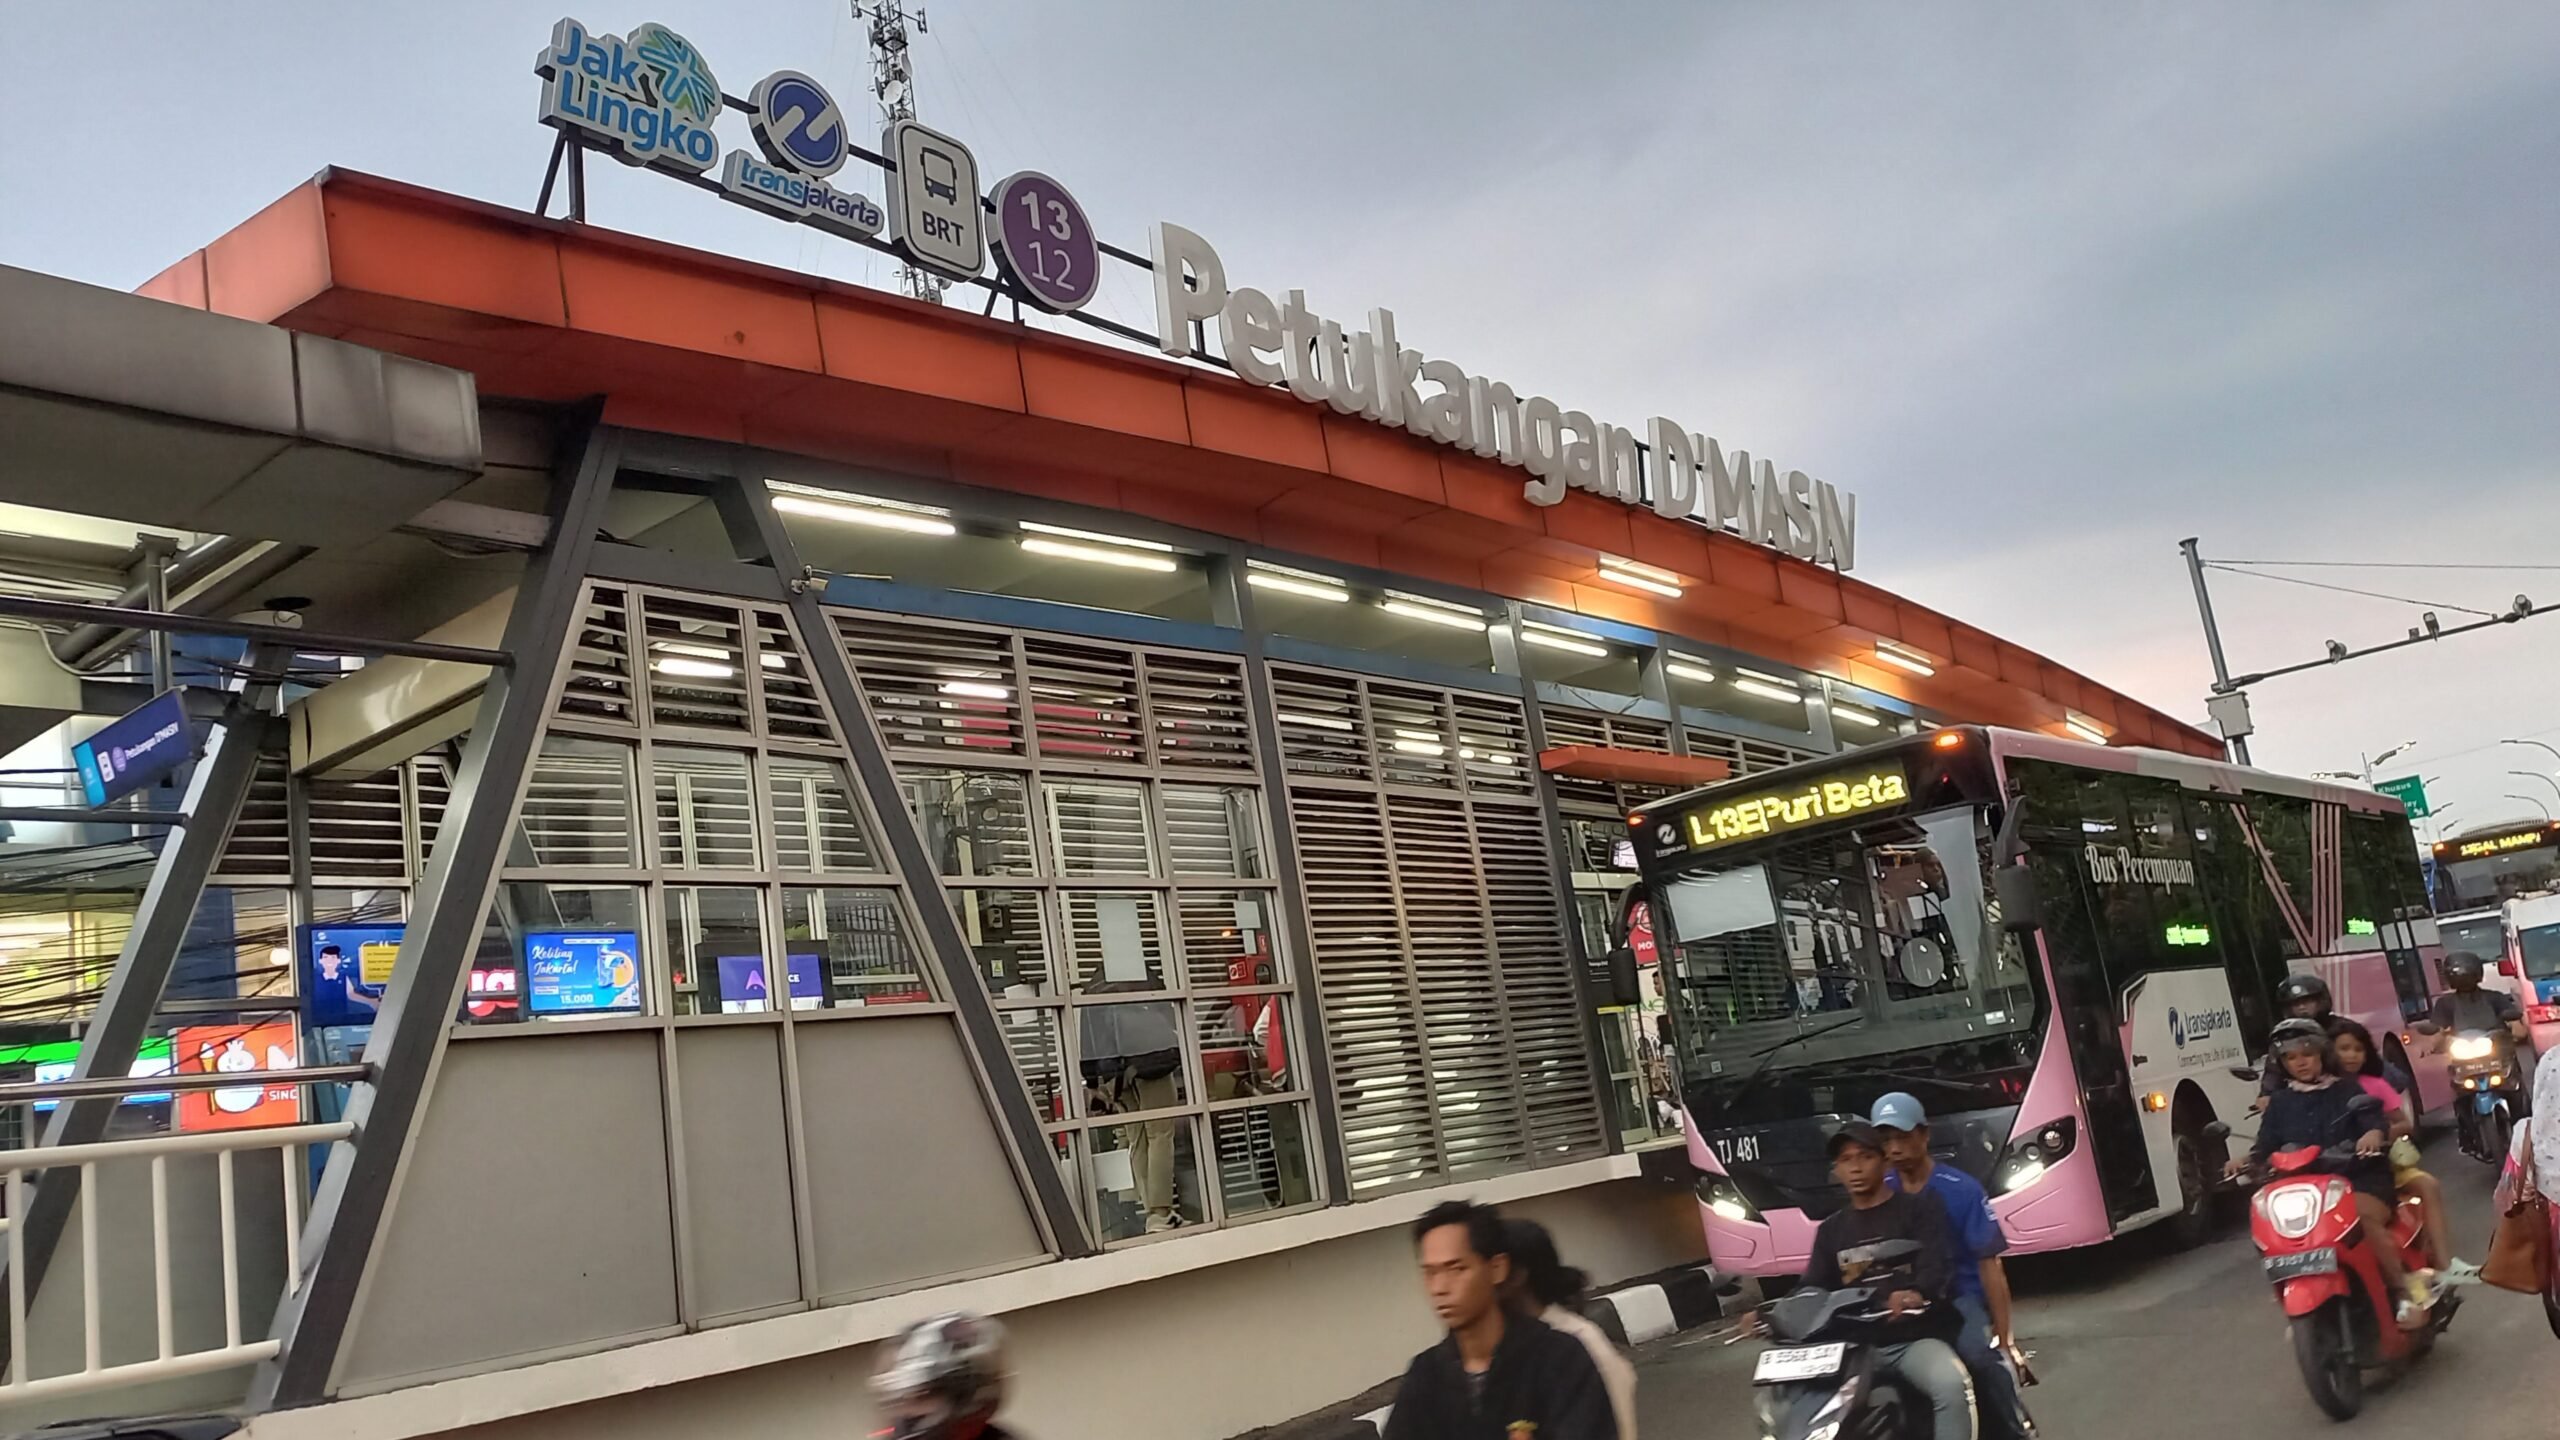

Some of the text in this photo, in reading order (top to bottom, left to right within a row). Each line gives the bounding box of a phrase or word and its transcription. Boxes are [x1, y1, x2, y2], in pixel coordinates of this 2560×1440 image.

[557, 27, 639, 93] Jak
[560, 70, 713, 163] Lingko
[740, 159, 880, 228] transjakarta
[1020, 191, 1072, 242] 13
[922, 214, 964, 247] BRT
[1031, 241, 1076, 293] 12
[1150, 222, 1639, 506] Petukangan
[1823, 774, 1907, 814] Beta
[2377, 782, 2412, 793] Khusus
[2084, 846, 2195, 895] Bus Perempuan
[2184, 1006, 2232, 1041] transjakarta
[1716, 1135, 1760, 1164] TJ 481
